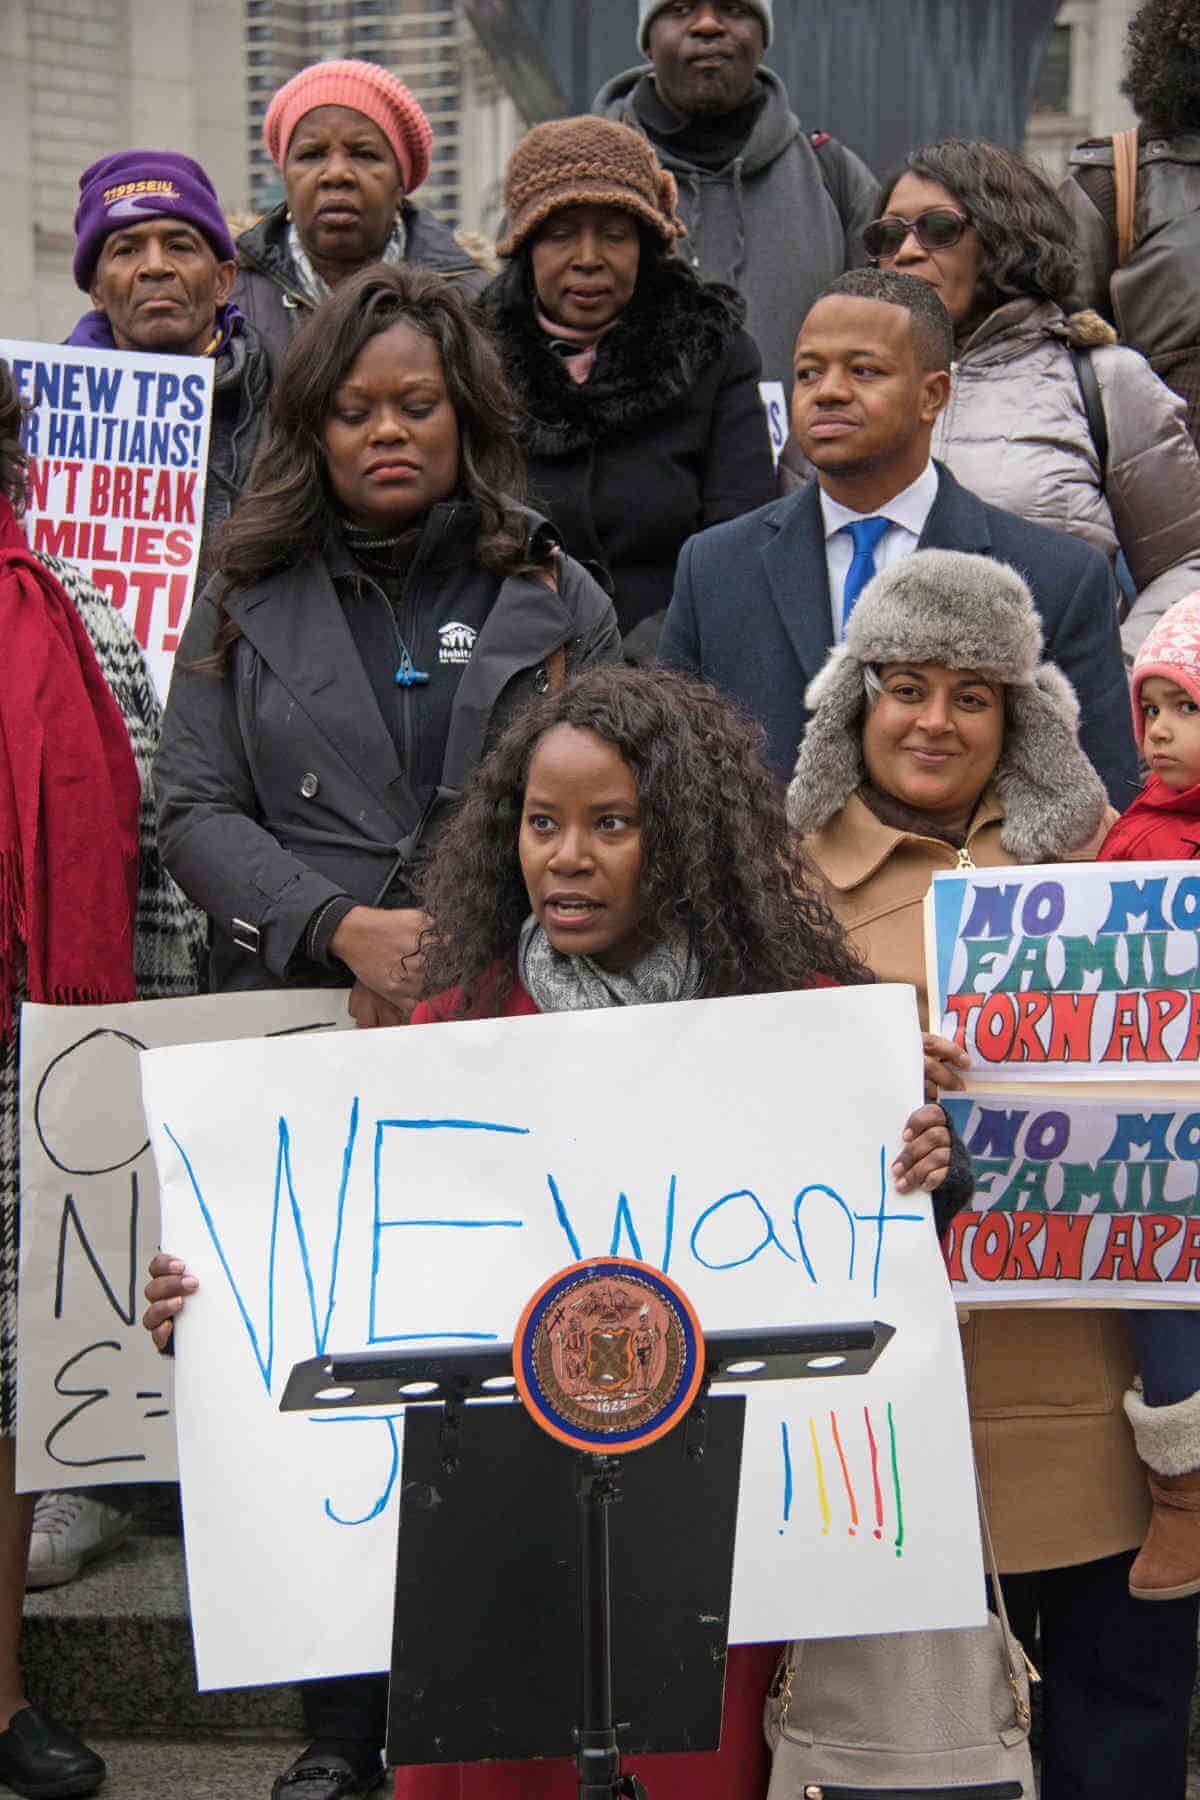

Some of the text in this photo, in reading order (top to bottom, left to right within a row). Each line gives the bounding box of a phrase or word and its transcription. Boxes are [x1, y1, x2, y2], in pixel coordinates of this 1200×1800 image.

[103, 179, 174, 203] 1199SEIU
[13, 359, 206, 421] ENEW TPS
[47, 412, 203, 468] HAITIANS!
[26, 458, 198, 525] N'T BREAK
[33, 518, 194, 568] MILIES
[959, 875, 1200, 938] NO MO
[958, 933, 1200, 994] FAMIL
[945, 991, 1099, 1063] TORN
[967, 1106, 1200, 1161] NO MO
[959, 1159, 1200, 1214] FAMIL
[162, 1095, 531, 1397] WE
[944, 1210, 1094, 1282] TORN
[596, 1399, 628, 1413] 1625
